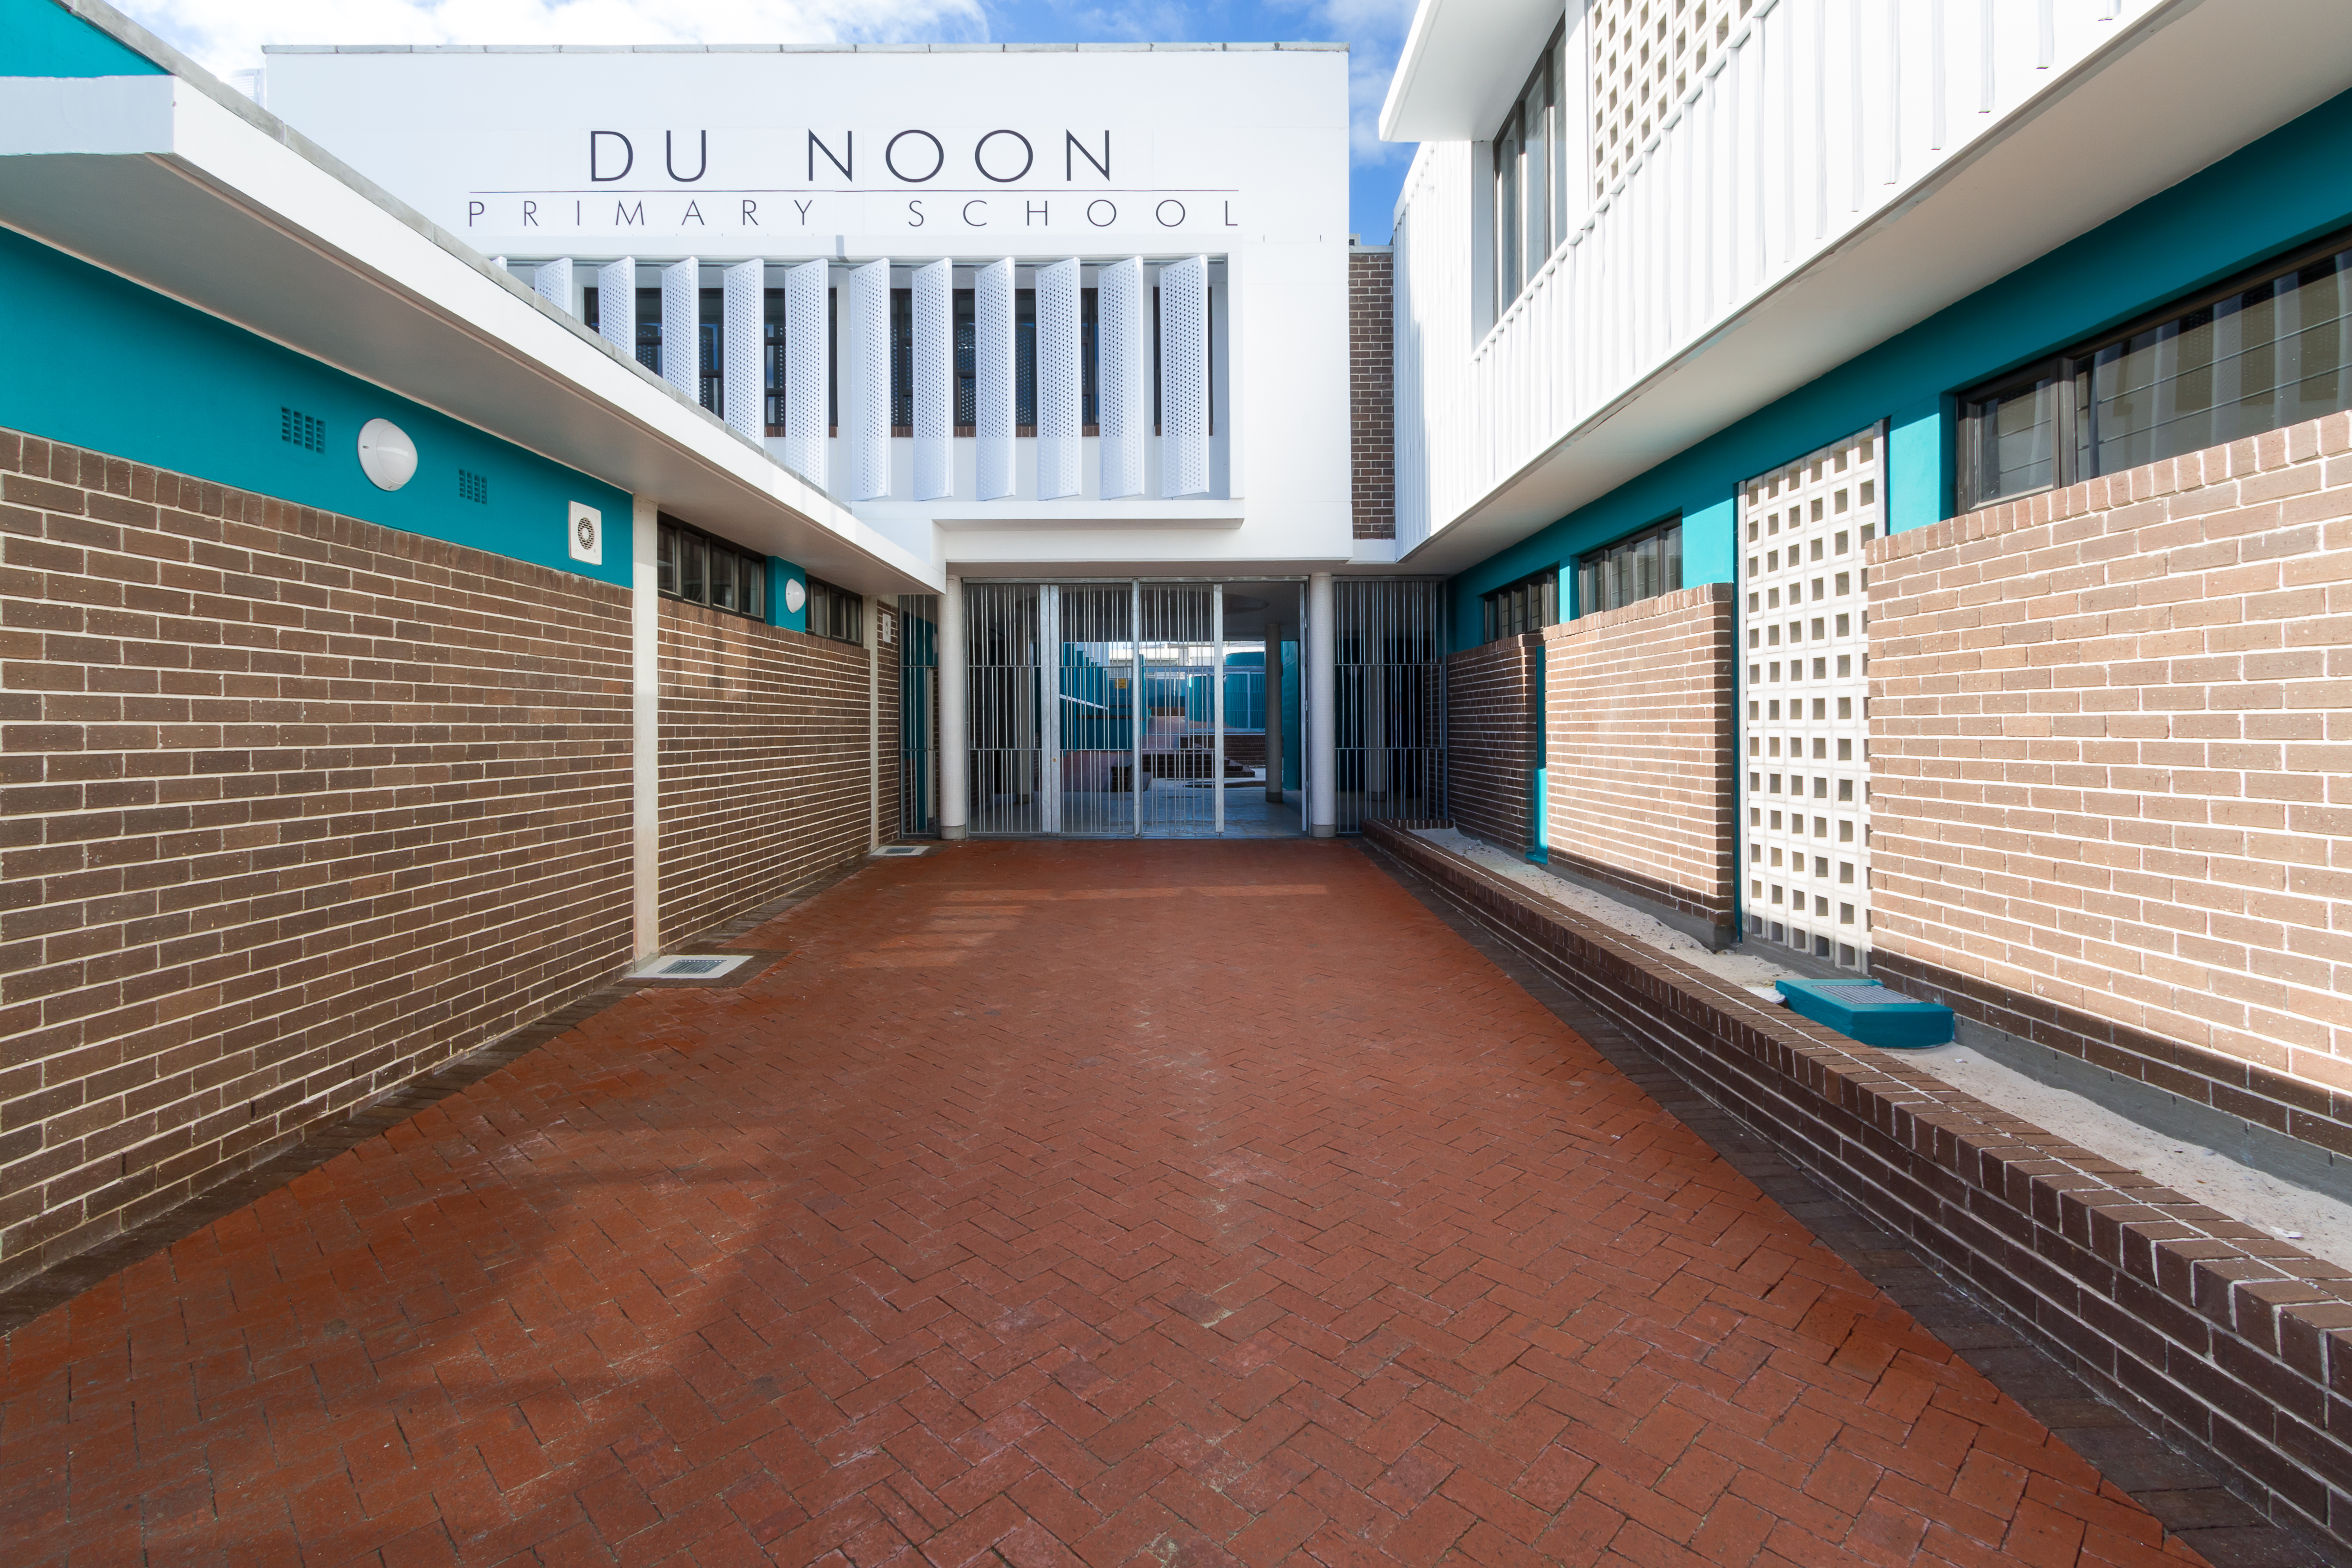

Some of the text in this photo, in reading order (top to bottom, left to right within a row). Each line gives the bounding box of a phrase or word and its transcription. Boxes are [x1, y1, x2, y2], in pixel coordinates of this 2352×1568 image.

[591, 128, 1110, 183] DU NOON
[469, 199, 1238, 227] PRIMARY SCHOOL
